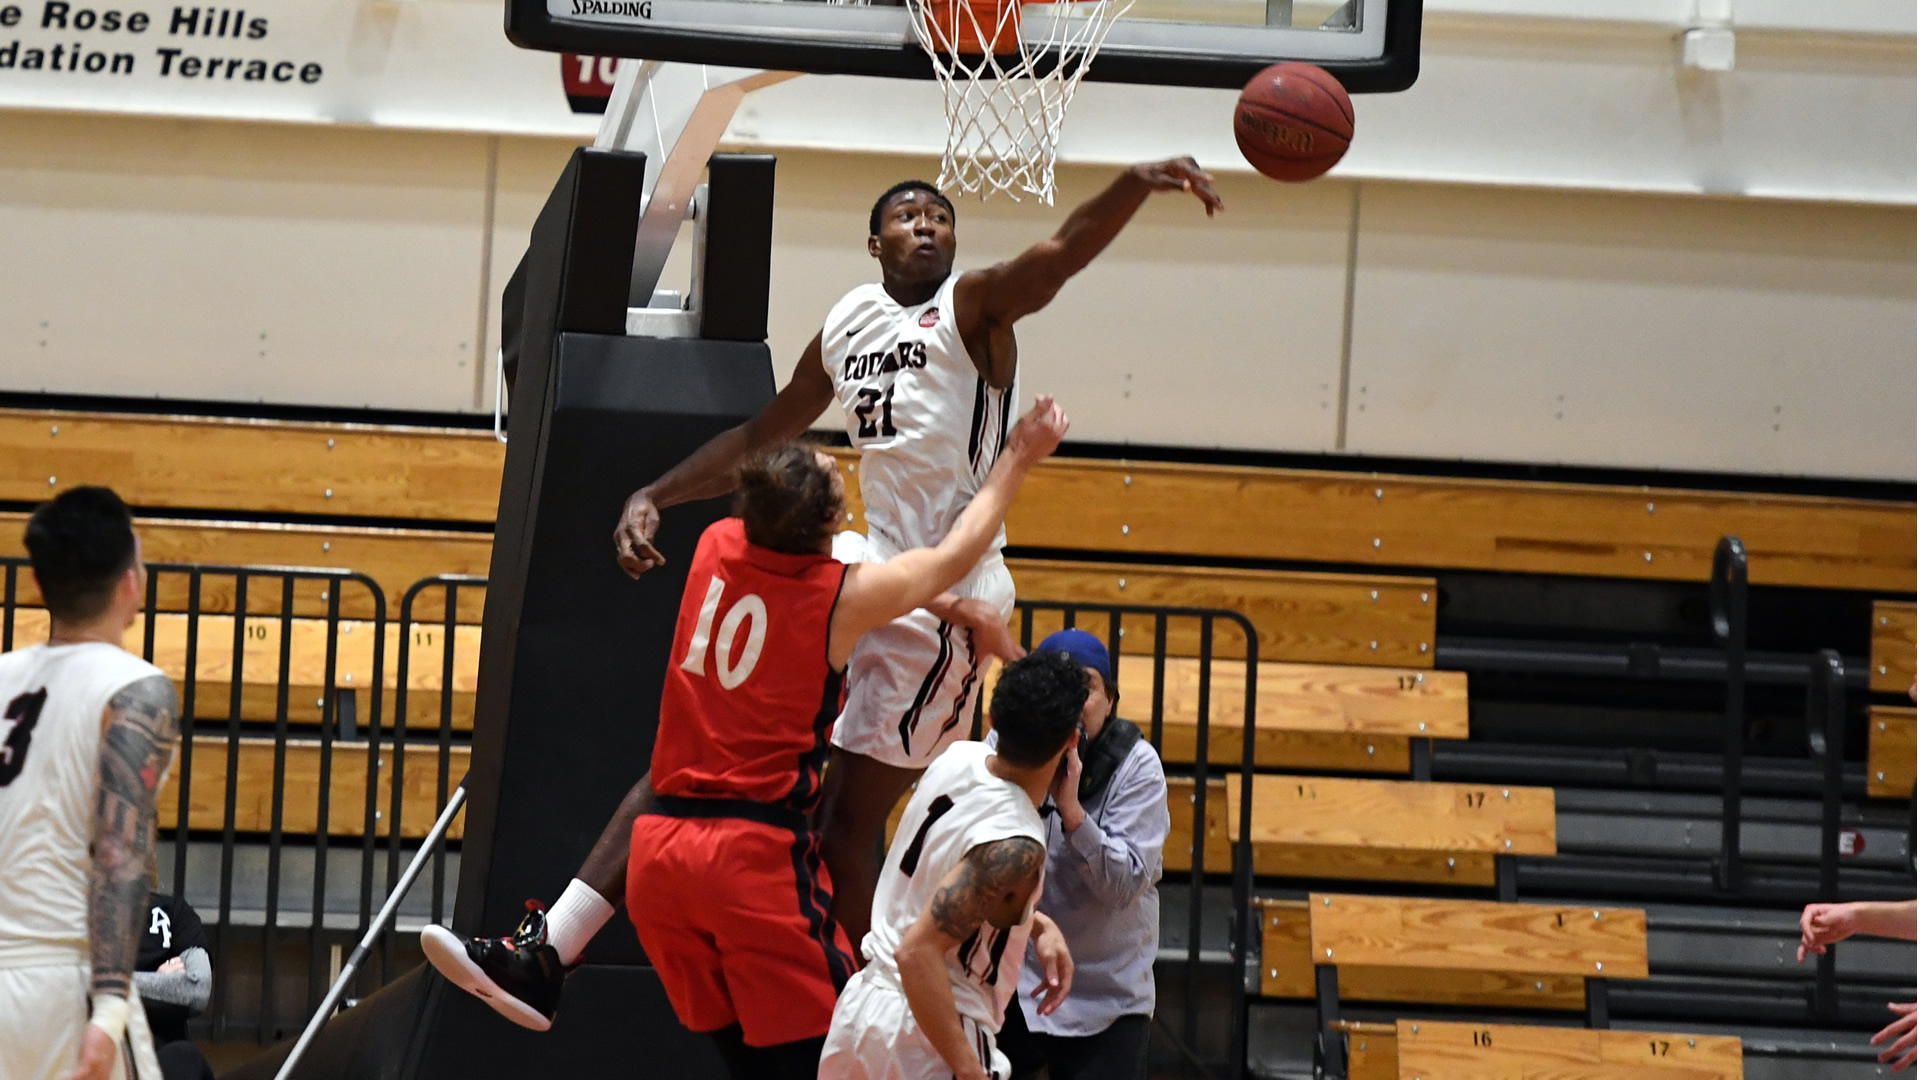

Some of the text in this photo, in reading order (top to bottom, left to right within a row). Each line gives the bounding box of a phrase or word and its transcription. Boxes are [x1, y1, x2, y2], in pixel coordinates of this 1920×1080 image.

[41, 0, 150, 33] Rose
[169, 7, 268, 39] Hills
[571, 0, 653, 20] SPALDING
[156, 48, 323, 84] Terrace
[854, 383, 897, 438] 21
[248, 625, 267, 641] 10
[415, 631, 432, 647] 11
[680, 574, 768, 691] 10
[1397, 675, 1417, 691] 17
[1466, 791, 1485, 809] 17
[899, 793, 955, 878] 1
[1472, 1030, 1493, 1048] 16
[1649, 1040, 1670, 1057] 17
